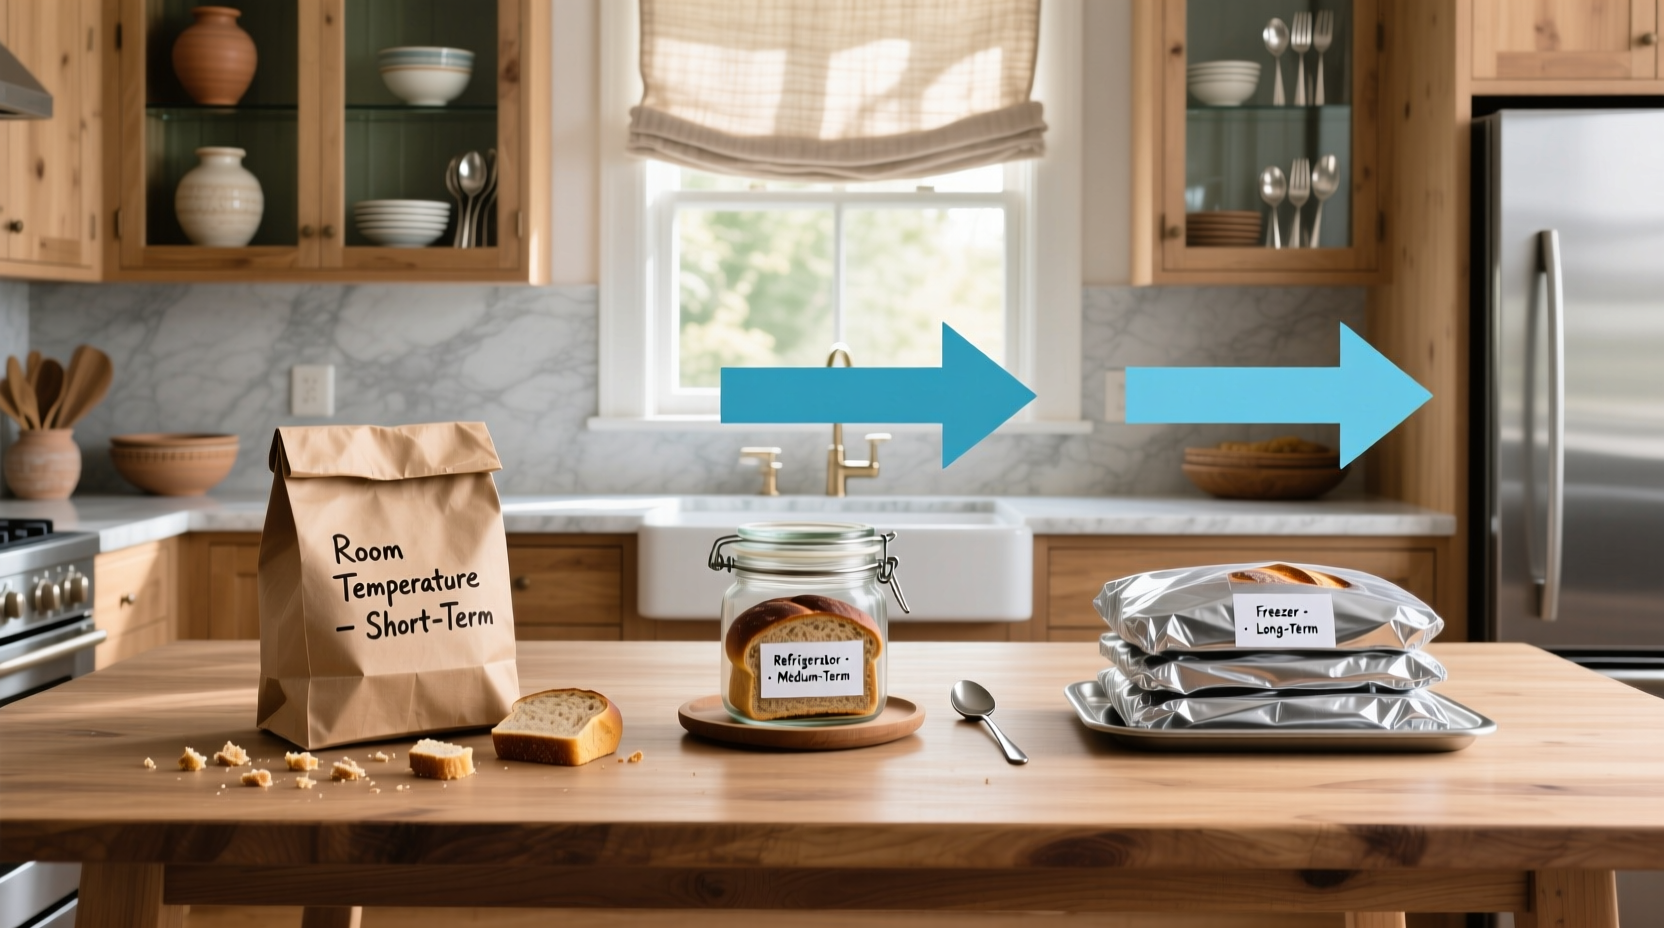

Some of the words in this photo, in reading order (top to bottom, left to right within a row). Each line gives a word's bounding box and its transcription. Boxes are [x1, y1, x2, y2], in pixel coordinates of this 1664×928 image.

[332, 533, 404, 565] Room
[332, 568, 480, 608] Temperature
[366, 601, 494, 640] Short-Term
[1256, 605, 1299, 618] Freezer
[1256, 622, 1318, 639] Long-Term
